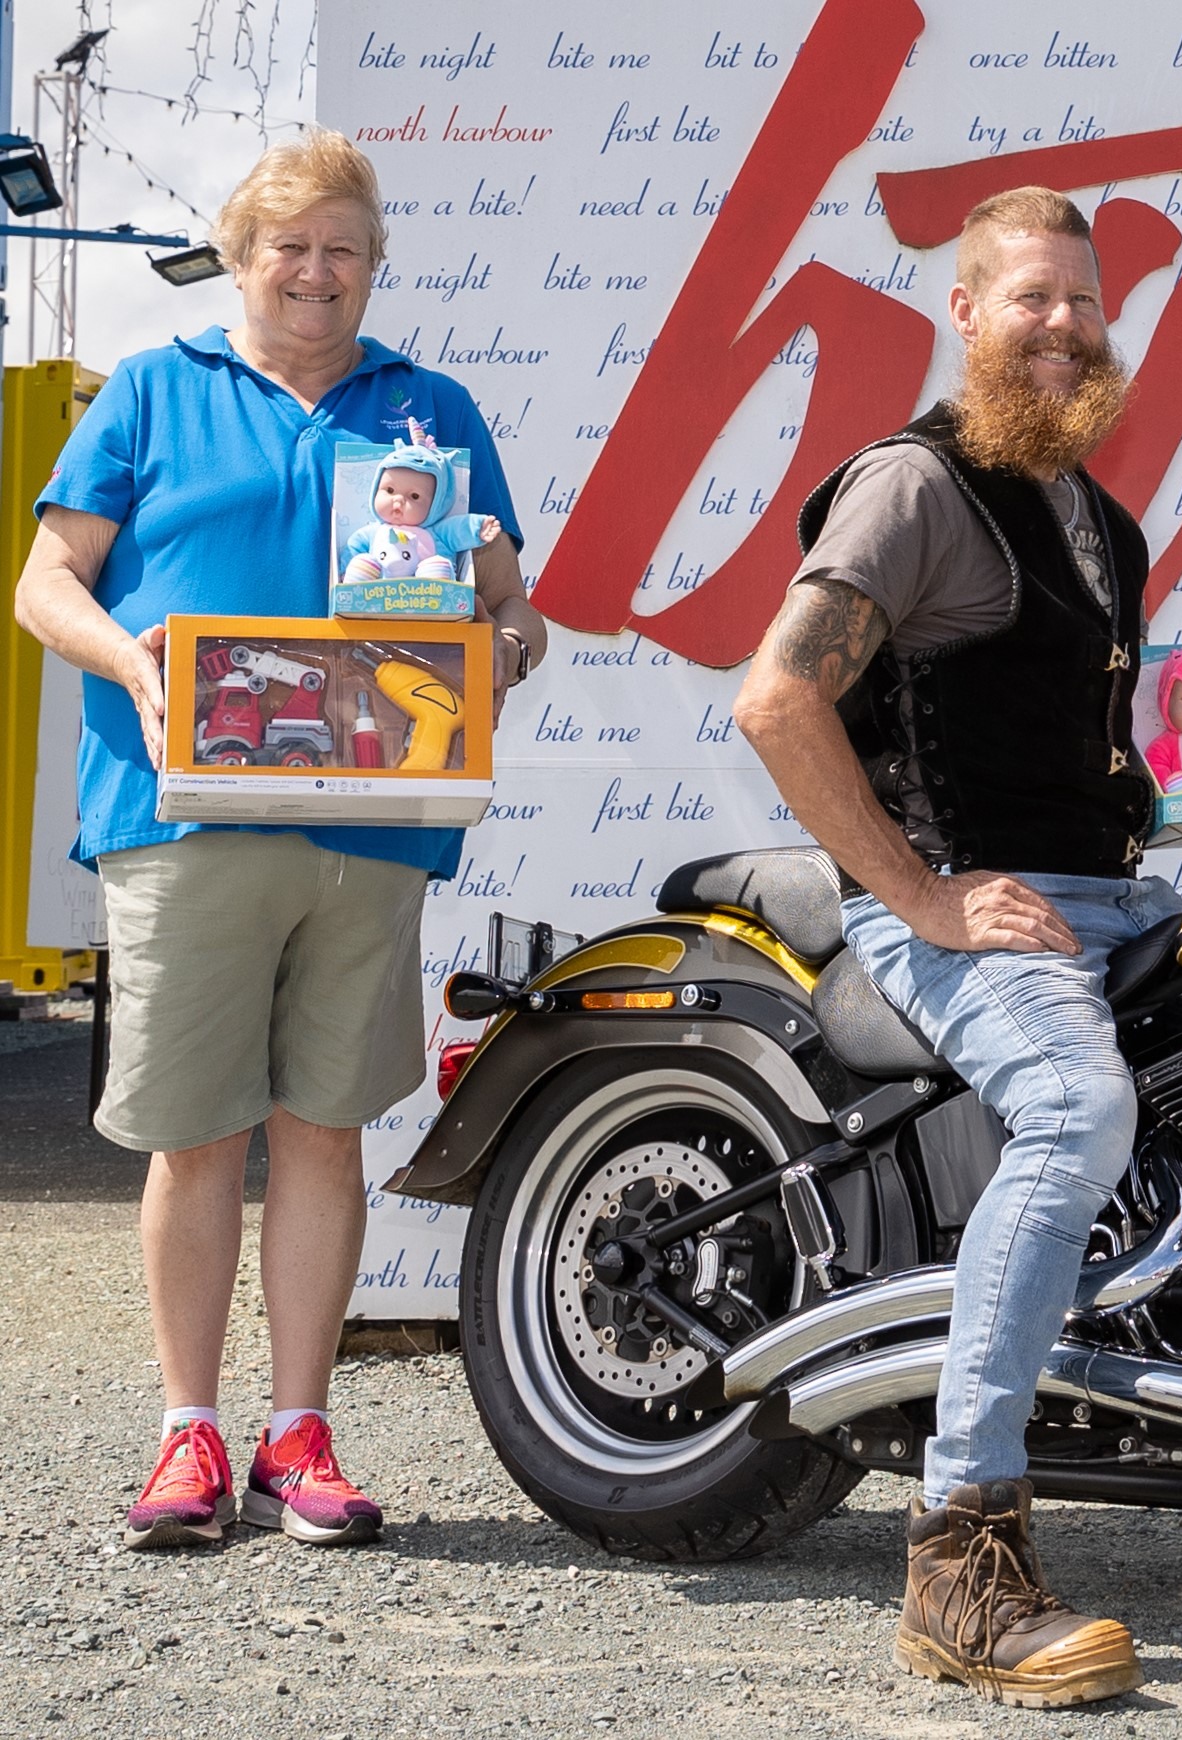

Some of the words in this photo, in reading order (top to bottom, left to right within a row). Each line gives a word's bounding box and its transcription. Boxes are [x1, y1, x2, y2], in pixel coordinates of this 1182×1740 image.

[359, 32, 405, 68] bite
[420, 32, 496, 81] night
[547, 32, 594, 68] bite
[609, 50, 650, 68] me
[704, 32, 742, 68] bit
[754, 41, 778, 68] to
[969, 52, 1029, 68] once
[1043, 31, 1118, 68] bitten
[356, 105, 427, 143] north
[443, 105, 553, 143] harbour
[601, 101, 660, 154] first
[673, 105, 720, 143] bite
[968, 116, 1006, 154] try
[1023, 127, 1043, 142] a
[1058, 105, 1105, 142] bite
[433, 199, 454, 216] a
[469, 175, 536, 216] bite!
[579, 178, 651, 216] need
[657, 199, 678, 216] a
[693, 178, 730, 216] bit
[810, 201, 848, 216] ore
[371, 264, 401, 290] ite
[415, 253, 492, 302] night
[544, 253, 590, 290] bite
[606, 273, 648, 290] me
[438, 327, 548, 364] harbour
[597, 323, 657, 376] firs
[540, 477, 578, 514] bit
[700, 477, 735, 515] bit
[668, 553, 711, 590] bit
[572, 634, 641, 666] need
[651, 652, 672, 666] a
[536, 703, 583, 742] bite
[598, 727, 641, 742] me
[592, 777, 653, 833] first
[666, 782, 714, 821] bite
[457, 855, 526, 897] bite!
[571, 859, 643, 898] need
[422, 936, 482, 988] ight
[355, 1249, 408, 1288] orth
